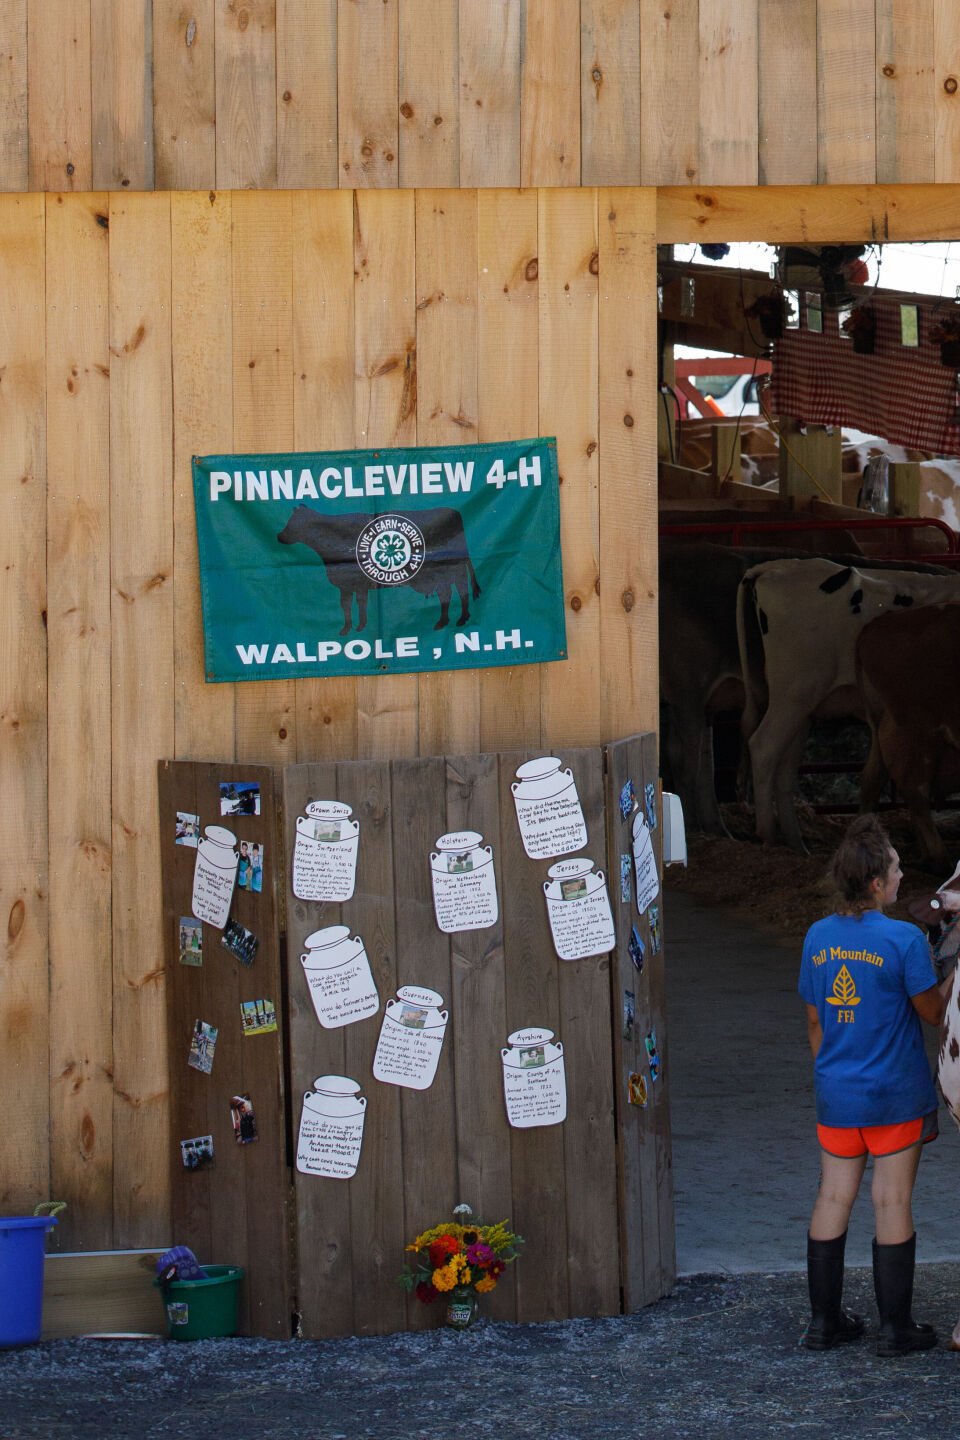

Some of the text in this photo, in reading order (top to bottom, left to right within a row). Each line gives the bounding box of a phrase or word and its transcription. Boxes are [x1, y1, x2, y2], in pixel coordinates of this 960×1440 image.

[210, 456, 542, 502] PINNACLEVIEW 4-H
[360, 534, 372, 552] LIVE
[400, 522, 422, 547] SERVE
[362, 554, 422, 582] THROUGH 4-H
[454, 629, 534, 653] N.H.
[310, 804, 330, 813] Brown
[556, 864, 579, 872] Jersey
[812, 946, 884, 968] Fall Mountain
[402, 988, 433, 1004] Guernsey
[837, 1009, 855, 1023] FFA
[517, 1034, 543, 1042] Ayrshire
